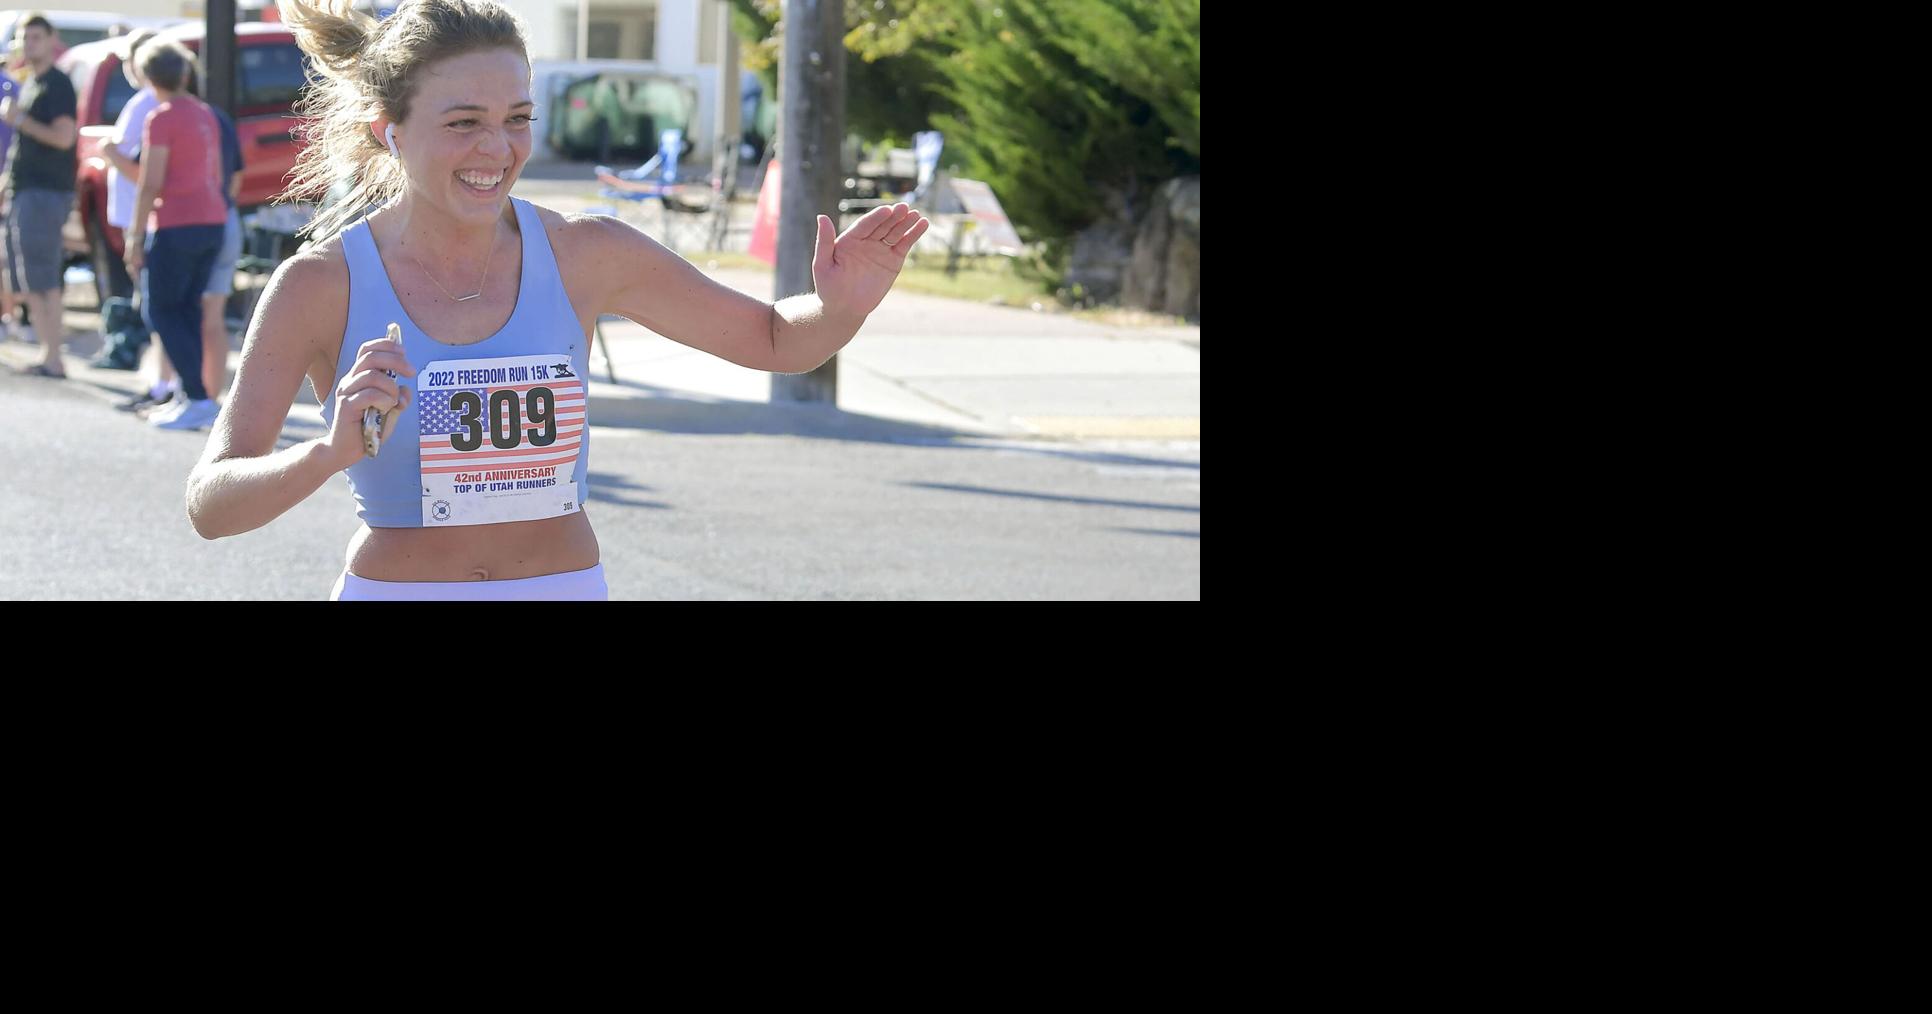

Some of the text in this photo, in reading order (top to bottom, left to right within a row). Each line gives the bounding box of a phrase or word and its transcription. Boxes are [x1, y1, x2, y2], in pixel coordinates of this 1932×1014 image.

[428, 364, 549, 387] 2022 FREEDOM RUN 15K
[450, 386, 557, 452] 309
[454, 466, 557, 483] 42nd ANNIVERSARY
[453, 477, 557, 494] TOP OF UTAH RUNNERS
